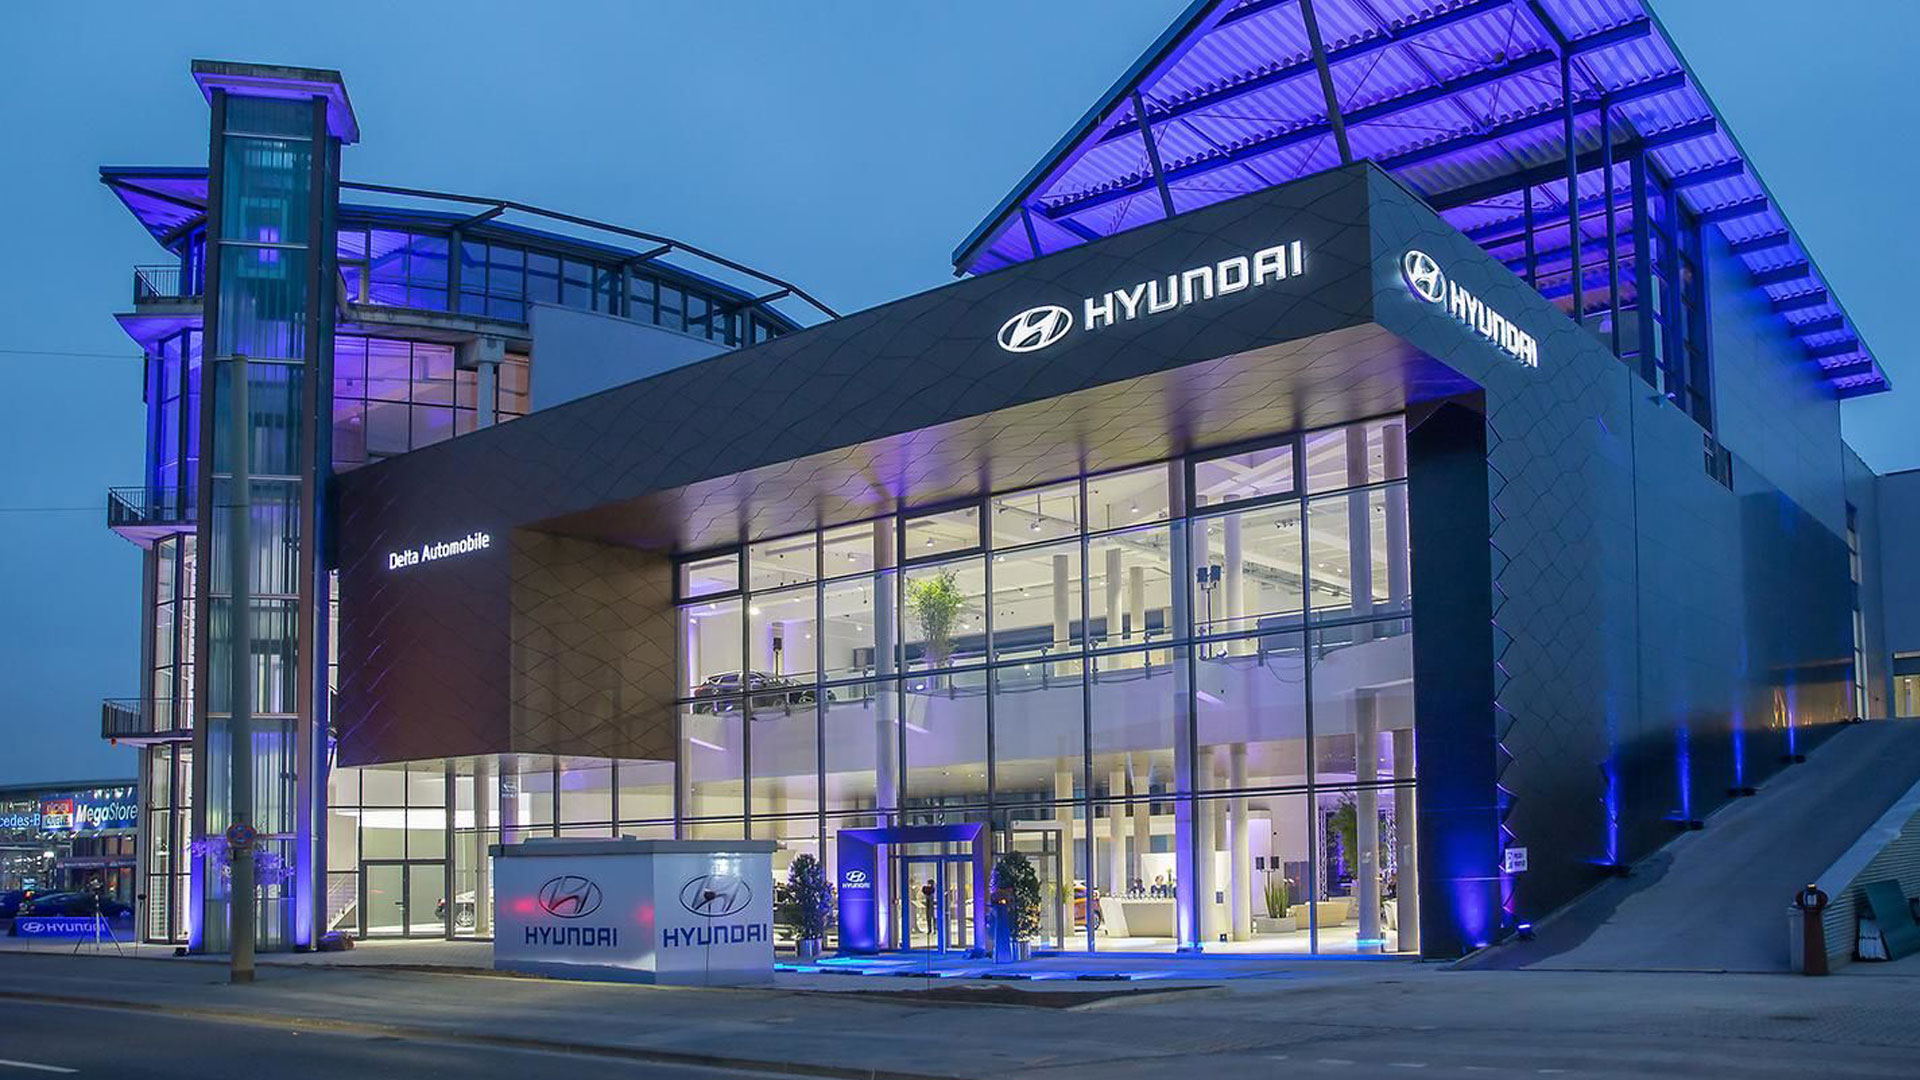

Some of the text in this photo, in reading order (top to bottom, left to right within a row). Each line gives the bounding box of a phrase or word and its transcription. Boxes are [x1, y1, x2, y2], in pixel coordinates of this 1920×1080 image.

[1084, 240, 1303, 331] HYUNDAI
[1449, 279, 1538, 368] HYUNDAI
[388, 532, 490, 570] Delta Automobile
[75, 802, 138, 827] MegaStore
[525, 926, 618, 947] HYUNDAI
[663, 923, 768, 948] HYUNDAI
